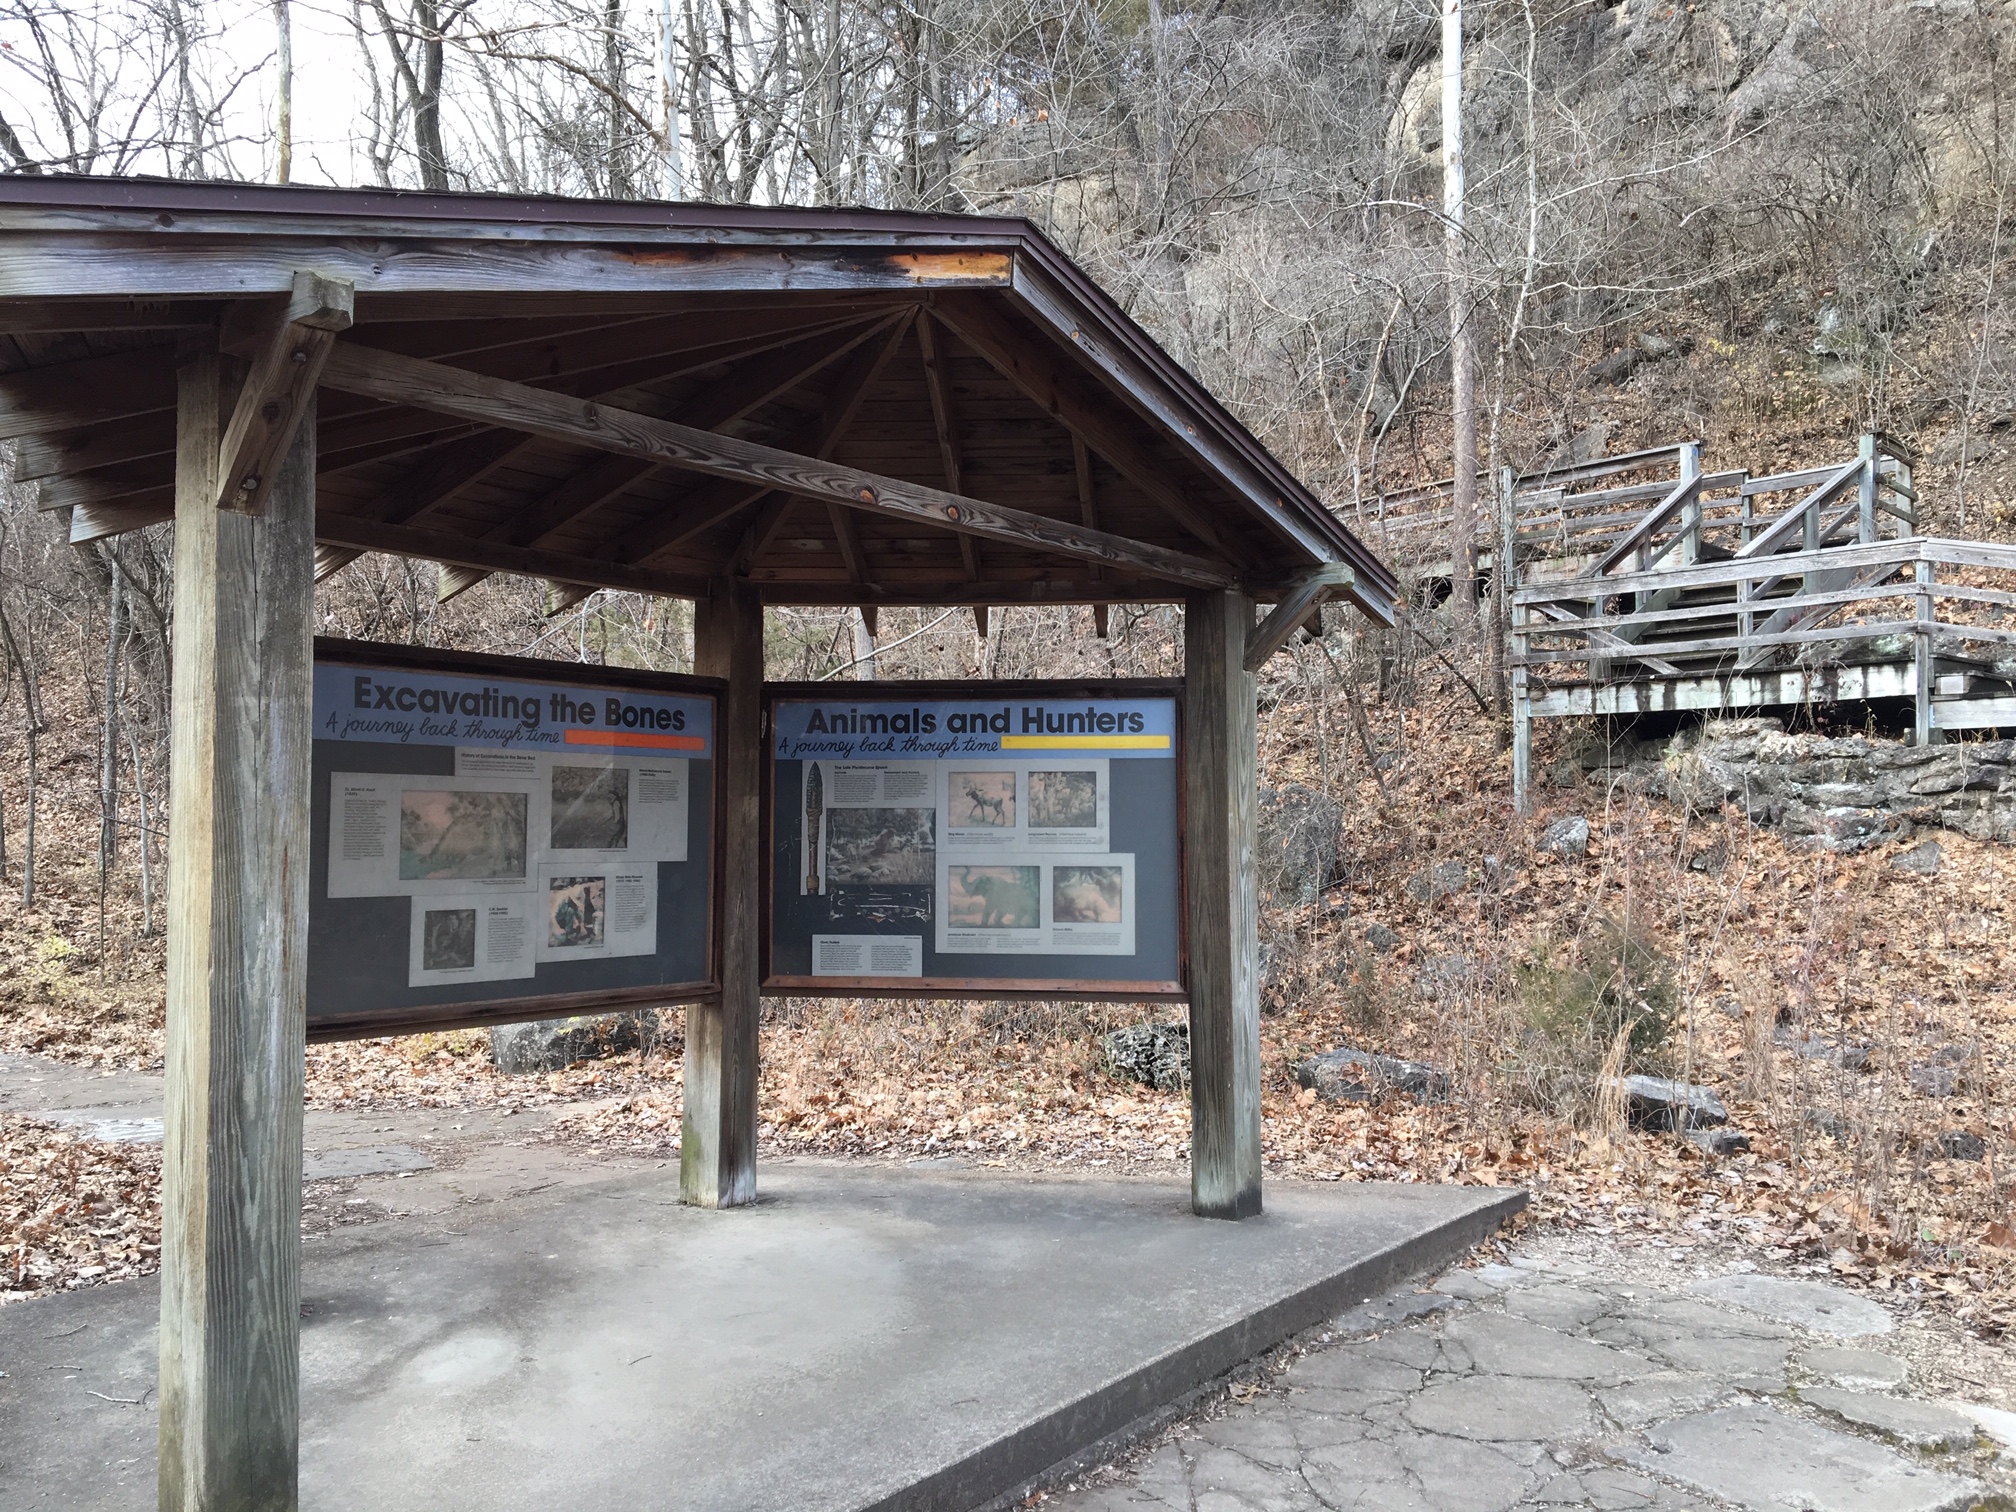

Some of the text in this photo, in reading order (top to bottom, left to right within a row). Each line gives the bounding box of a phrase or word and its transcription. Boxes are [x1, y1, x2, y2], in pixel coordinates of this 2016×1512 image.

[354, 676, 686, 731] Excavating the Bones
[325, 711, 560, 748] A journey back through time
[805, 706, 1145, 734] Animals and Hunters
[778, 735, 999, 759] A journey back through time
